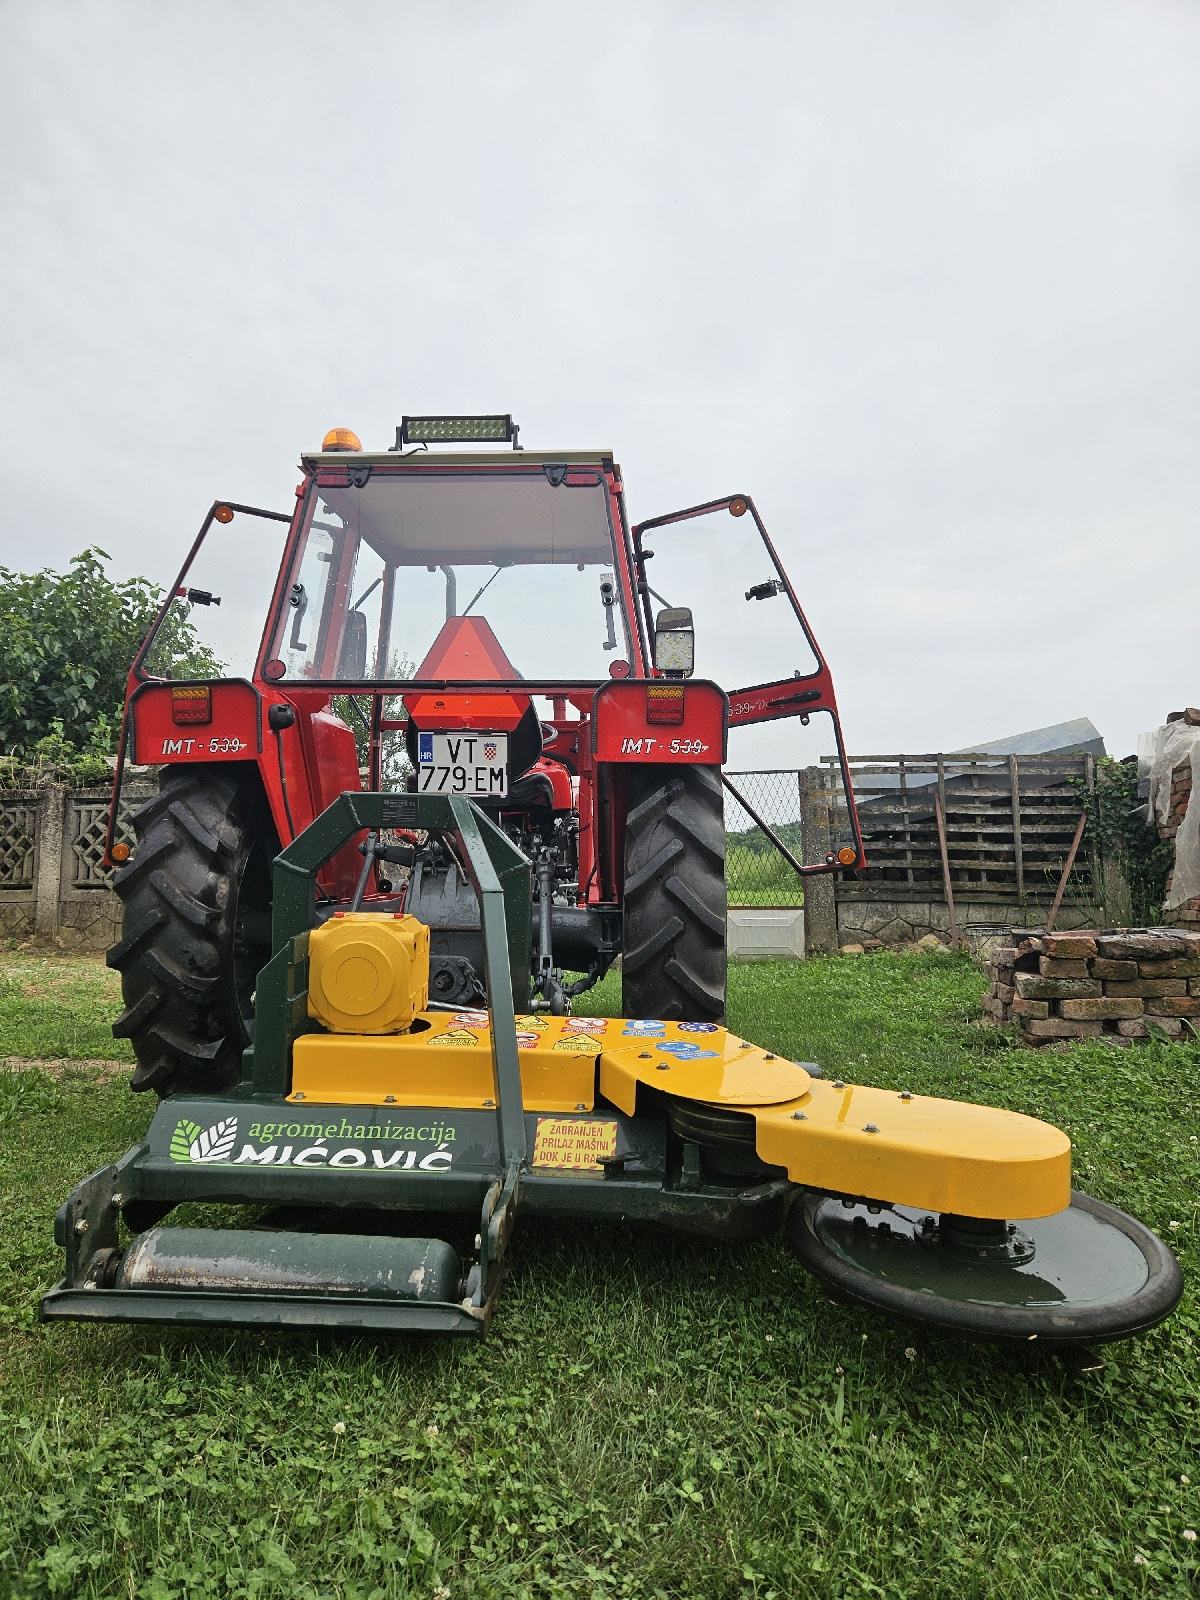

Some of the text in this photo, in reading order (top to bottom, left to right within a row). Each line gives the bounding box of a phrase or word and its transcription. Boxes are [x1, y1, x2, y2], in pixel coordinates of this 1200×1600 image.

[161, 739, 196, 755] IMT
[209, 738, 244, 753] 539
[446, 738, 478, 764] VT
[621, 738, 657, 754] IMT
[669, 739, 706, 754] 539
[420, 751, 433, 760] HR
[421, 765, 504, 792] 779-EM
[248, 1118, 457, 1146] agromehanizacija
[550, 1125, 603, 1137] ZABRANJEN
[542, 1138, 609, 1151] PRILAZ MAŠINI
[232, 1137, 453, 1171] MIĆOVIĆ
[540, 1151, 559, 1162] DOK
[561, 1153, 573, 1163] JE
[575, 1153, 581, 1163] U
